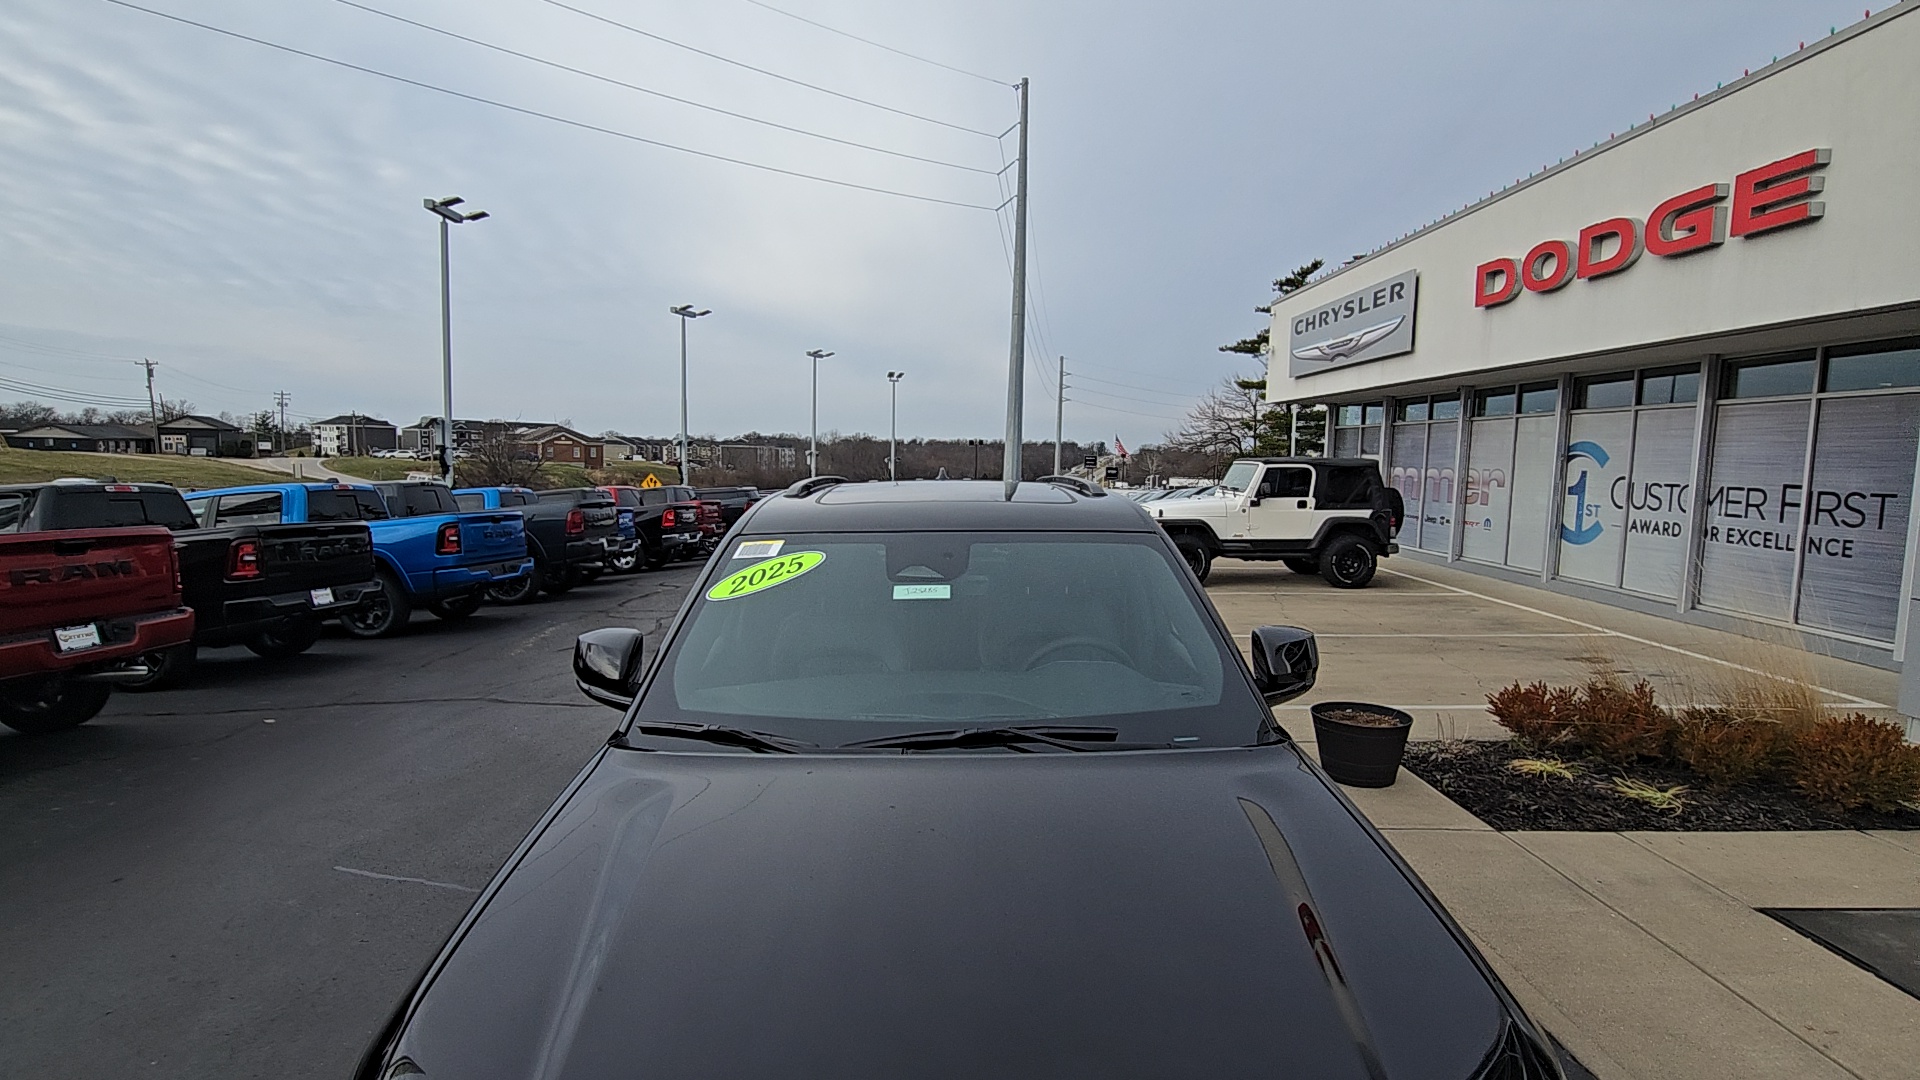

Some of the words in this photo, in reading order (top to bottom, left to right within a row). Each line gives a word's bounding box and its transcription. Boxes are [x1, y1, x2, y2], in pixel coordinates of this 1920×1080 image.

[1474, 147, 1832, 308] DODGE
[1293, 281, 1406, 336] CHRYSLER
[1778, 484, 1899, 530] FIRST
[1629, 519, 1682, 538] AWARD
[1725, 527, 1854, 560] EXCELLNCE
[9, 560, 132, 586] RAM
[727, 554, 805, 596] 2025
